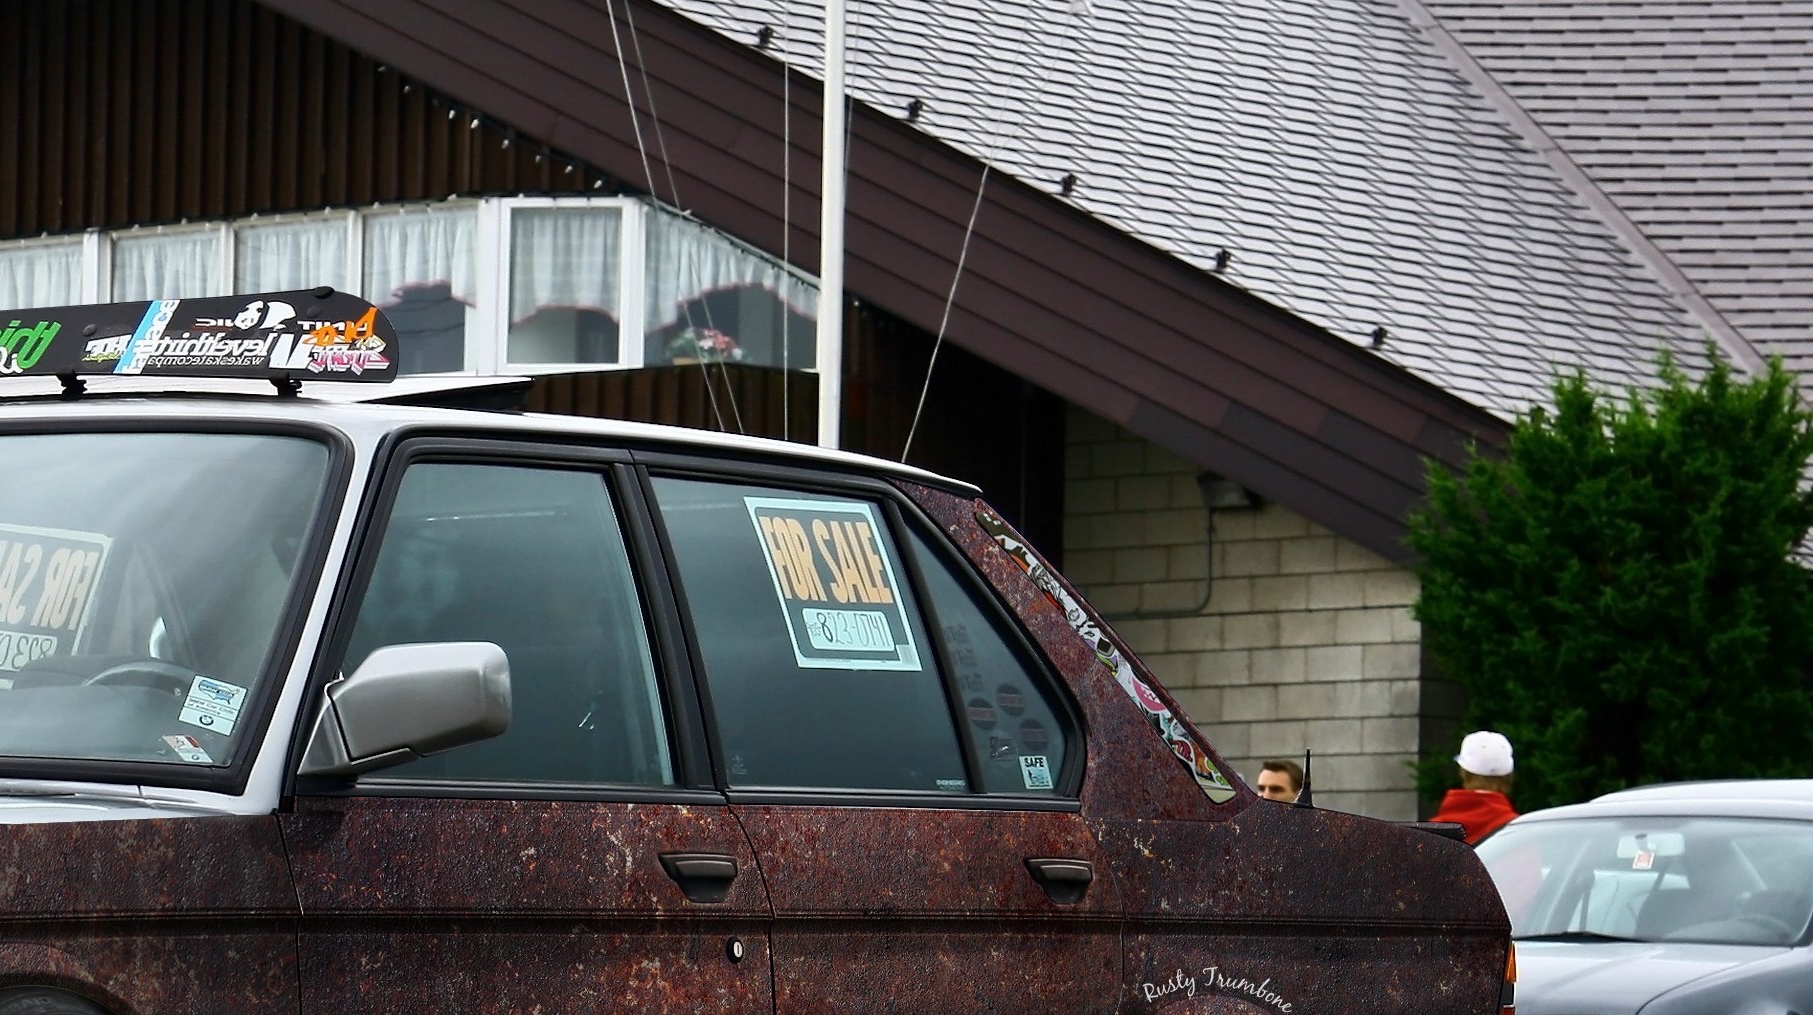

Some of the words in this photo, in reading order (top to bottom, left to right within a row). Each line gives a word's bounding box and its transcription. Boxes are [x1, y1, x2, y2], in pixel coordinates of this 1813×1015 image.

[758, 516, 828, 602] FOR
[812, 518, 894, 604] SALE
[1024, 757, 1045, 768] SAFE
[1142, 968, 1196, 1003] Rusty
[1202, 966, 1293, 1013] Trumbone
